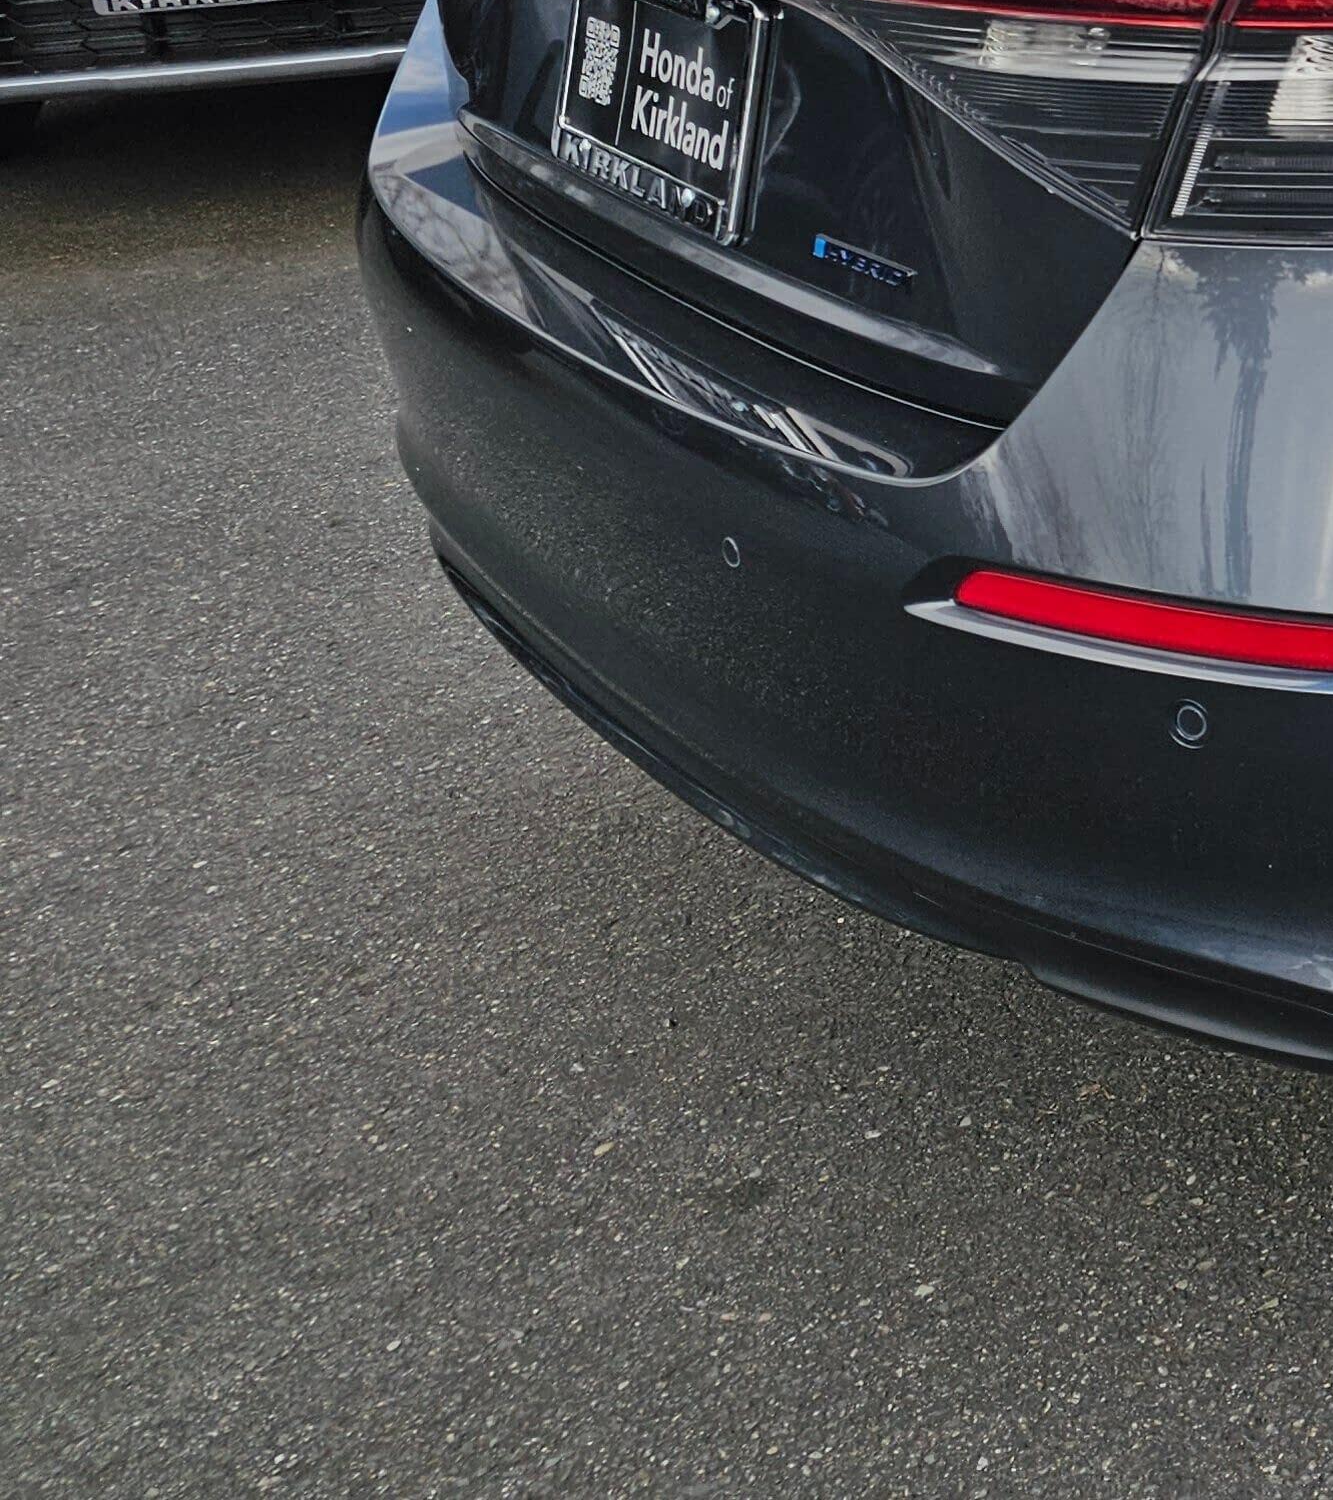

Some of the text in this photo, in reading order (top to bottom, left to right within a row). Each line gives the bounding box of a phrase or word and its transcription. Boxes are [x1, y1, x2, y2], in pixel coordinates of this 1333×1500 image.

[640, 28, 735, 109] Honda of
[631, 85, 729, 170] Kirkland
[562, 133, 712, 227] KIRKLAND
